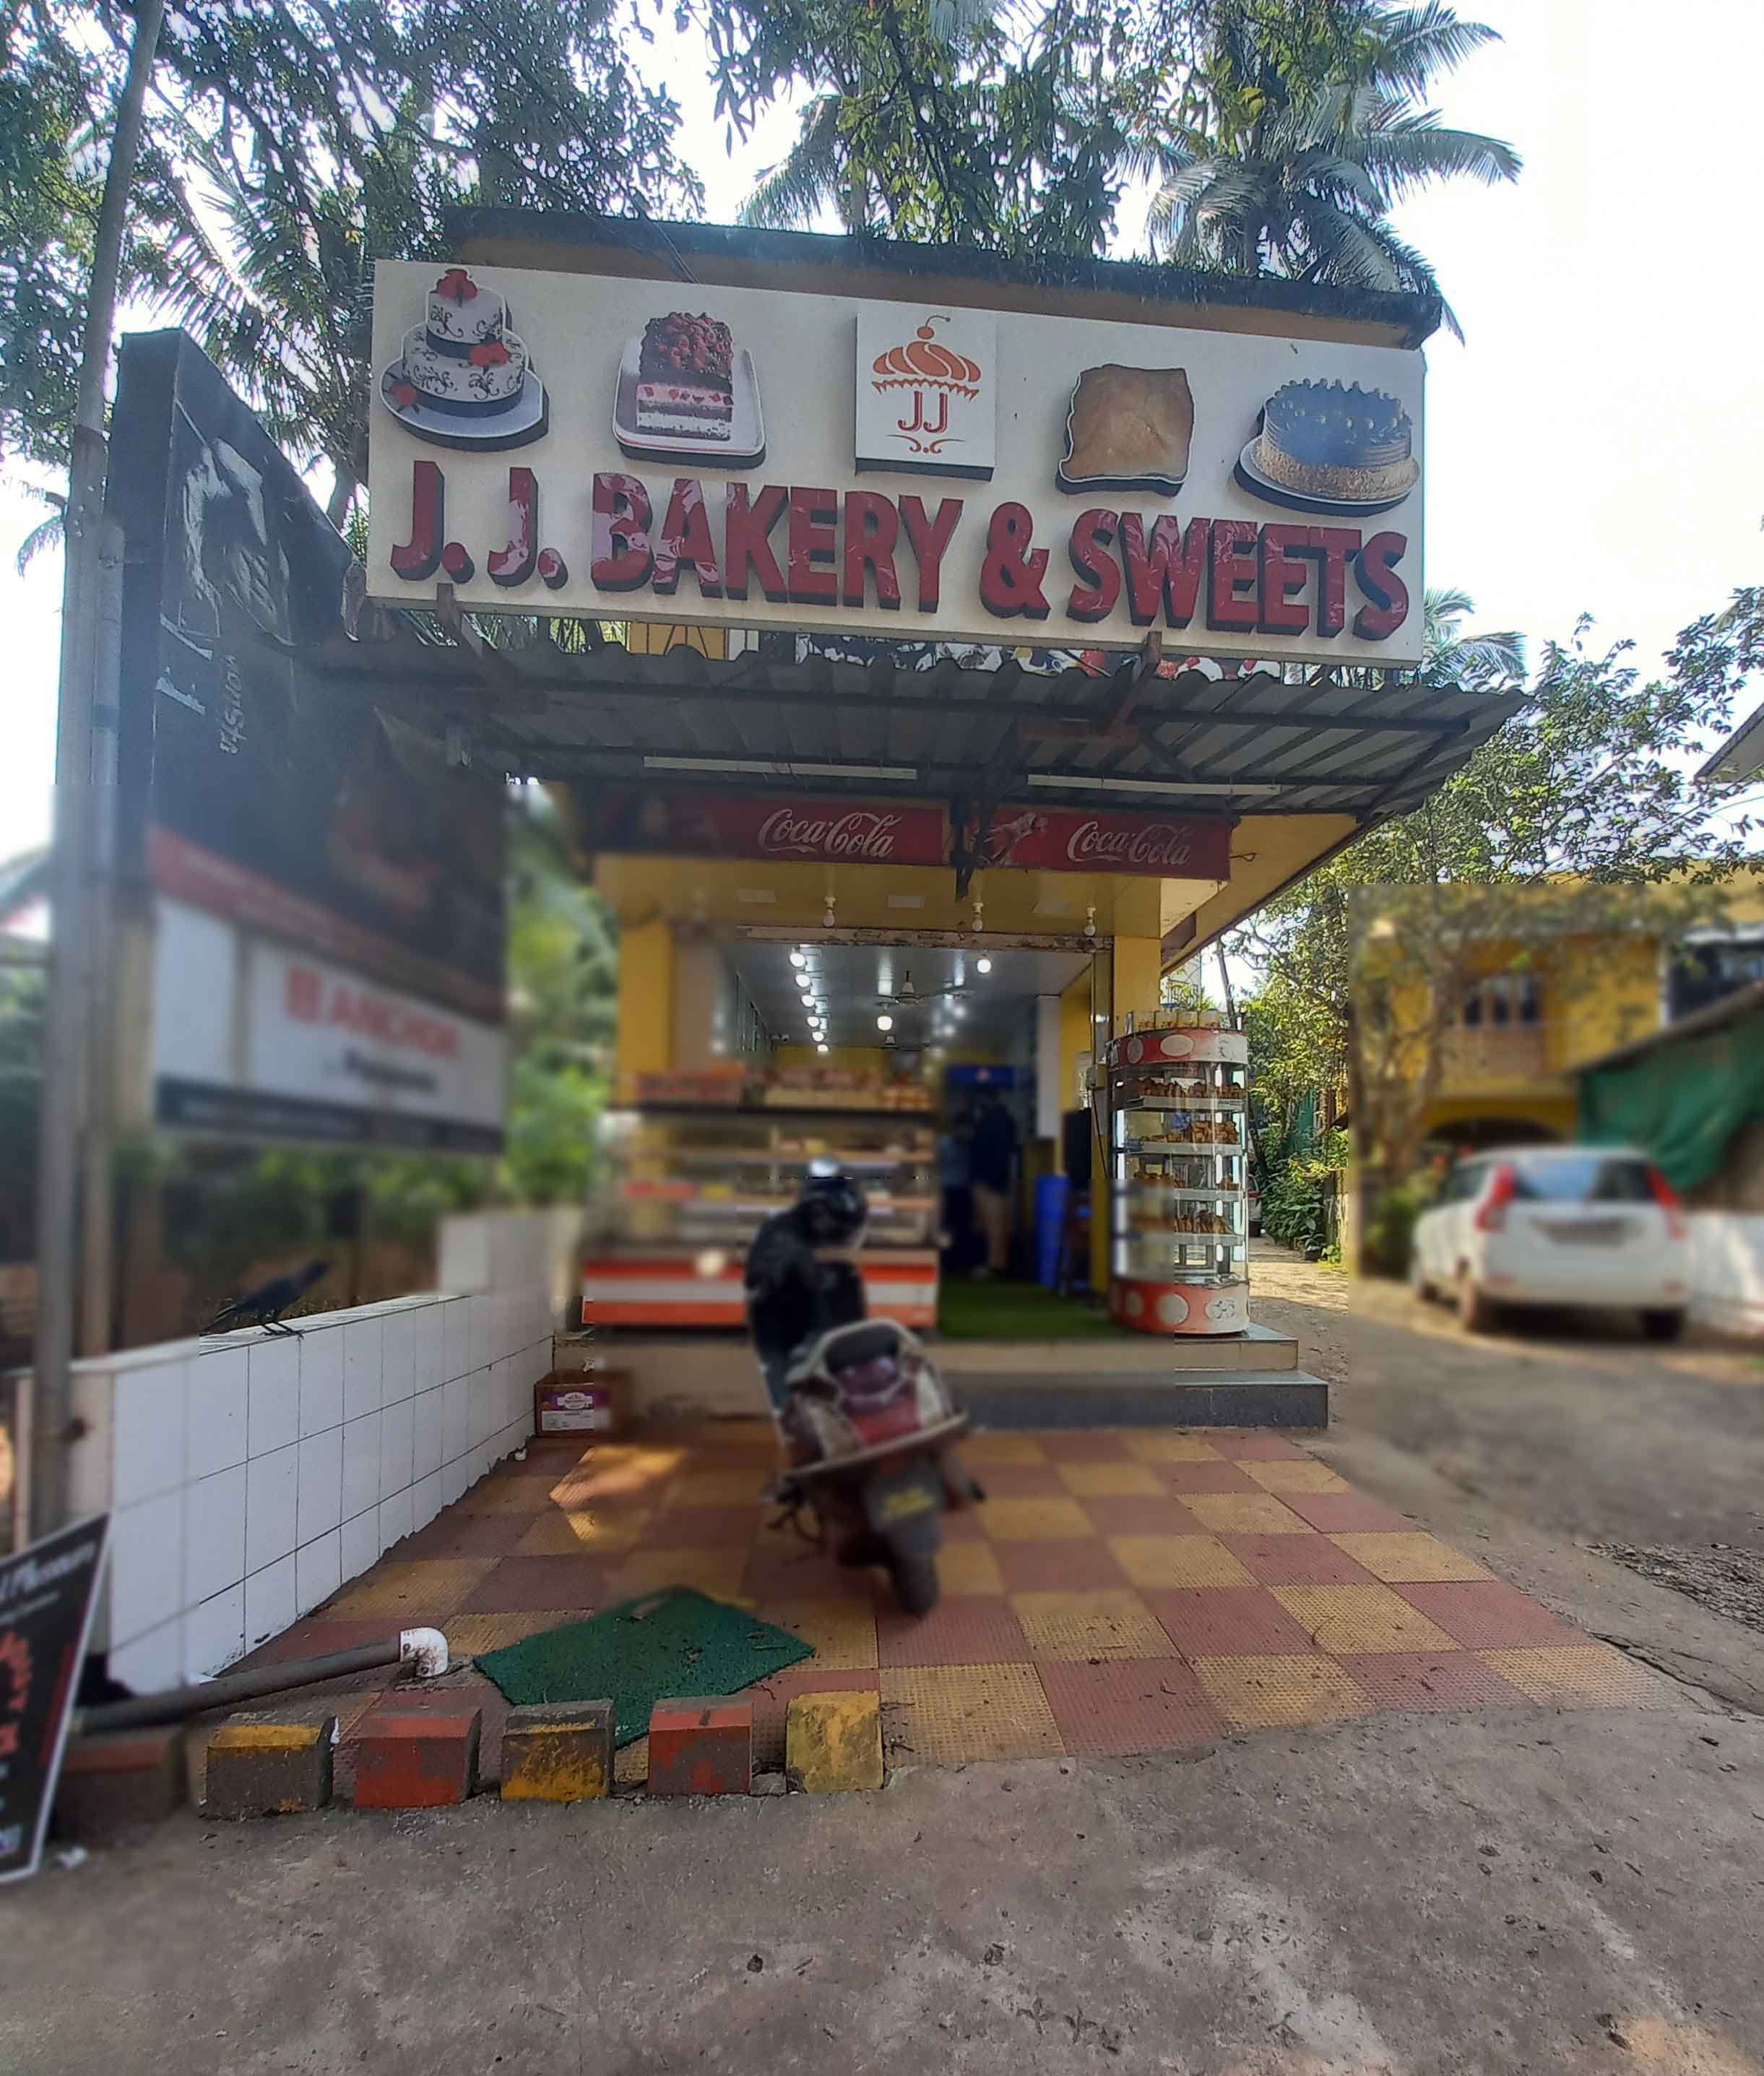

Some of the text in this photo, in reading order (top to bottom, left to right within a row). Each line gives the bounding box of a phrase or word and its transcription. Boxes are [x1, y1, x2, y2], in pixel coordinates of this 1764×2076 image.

[898, 391, 948, 433] JJ
[390, 459, 1409, 641] J.J. BAKERY & SWEETS
[758, 808, 902, 858] Coca-Cola
[1067, 821, 1194, 865] Coca-Cola
